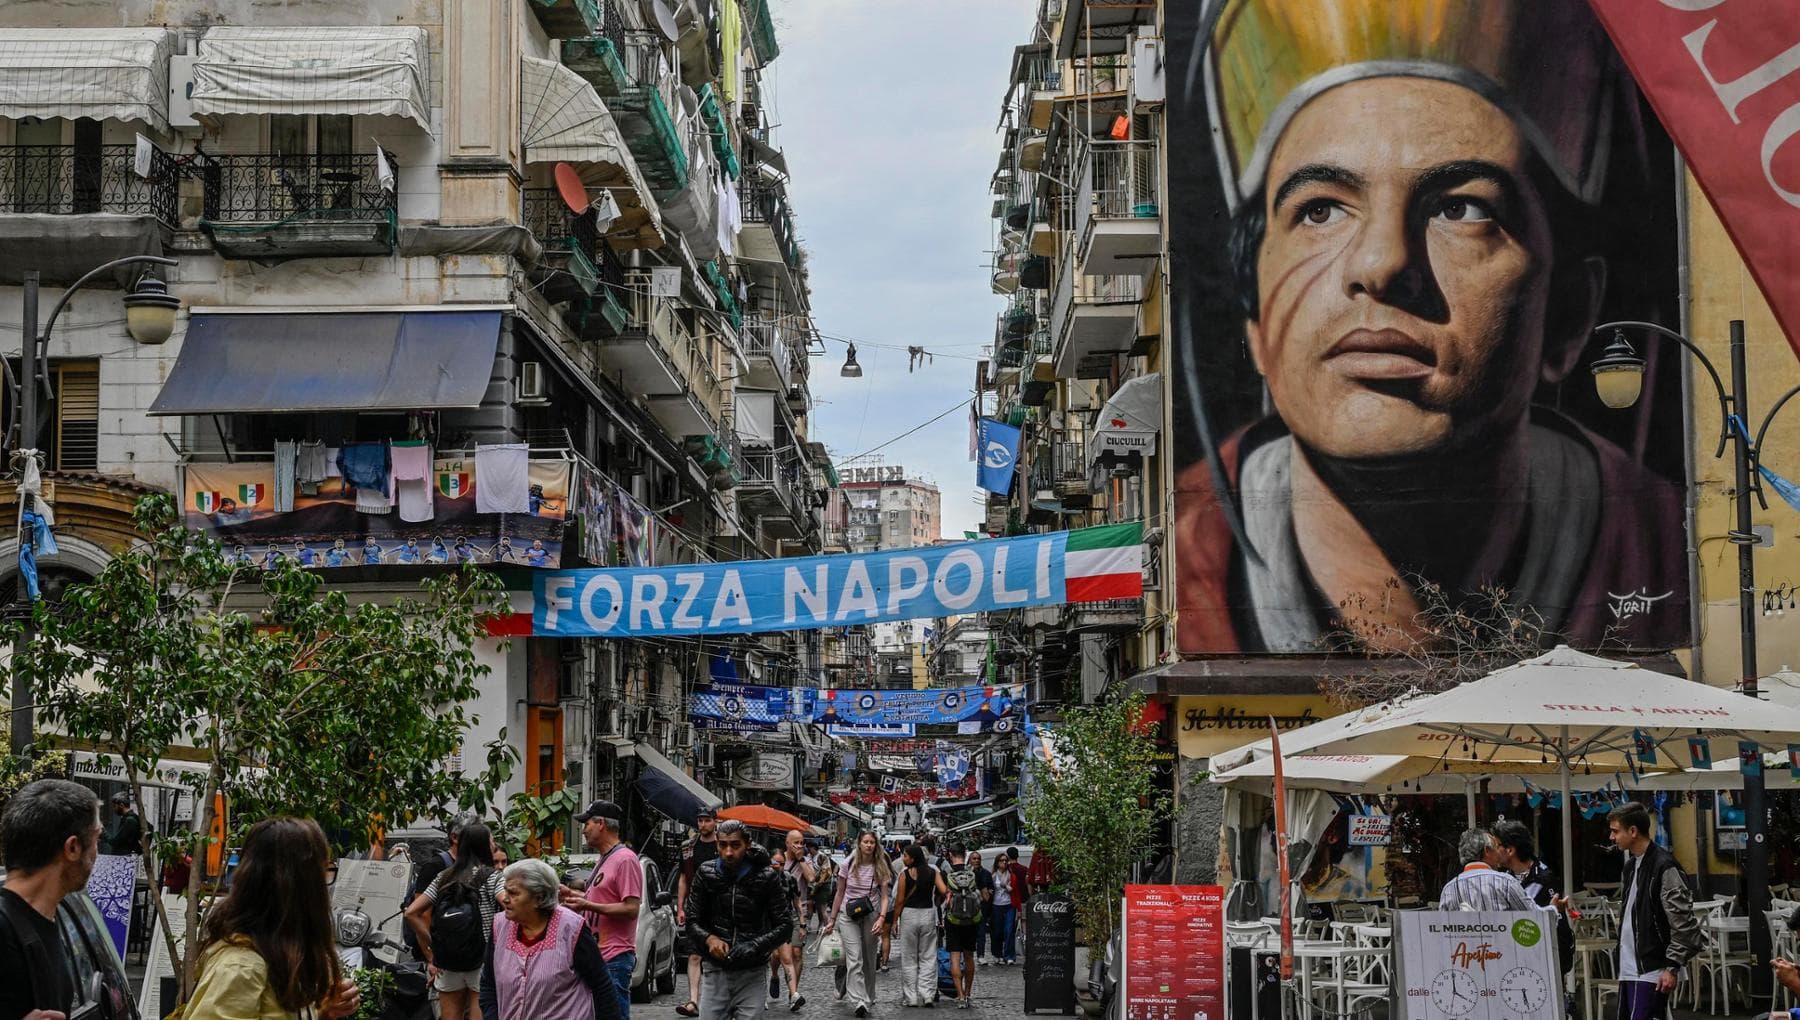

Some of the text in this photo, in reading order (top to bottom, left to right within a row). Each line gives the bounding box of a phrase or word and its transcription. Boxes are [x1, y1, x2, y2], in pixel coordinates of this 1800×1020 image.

[1106, 436, 1147, 446] CIUCULILL
[450, 478, 459, 489] 3
[247, 487, 257, 499] 2
[204, 494, 212, 505] 1
[544, 539, 1051, 631] FORZA NAPOLI
[1543, 703, 1730, 717] STELLA ARTOIS
[884, 779, 894, 788] P
[1429, 924, 1507, 933] IL MIRACOLO
[1408, 988, 1496, 997] dalle alle
